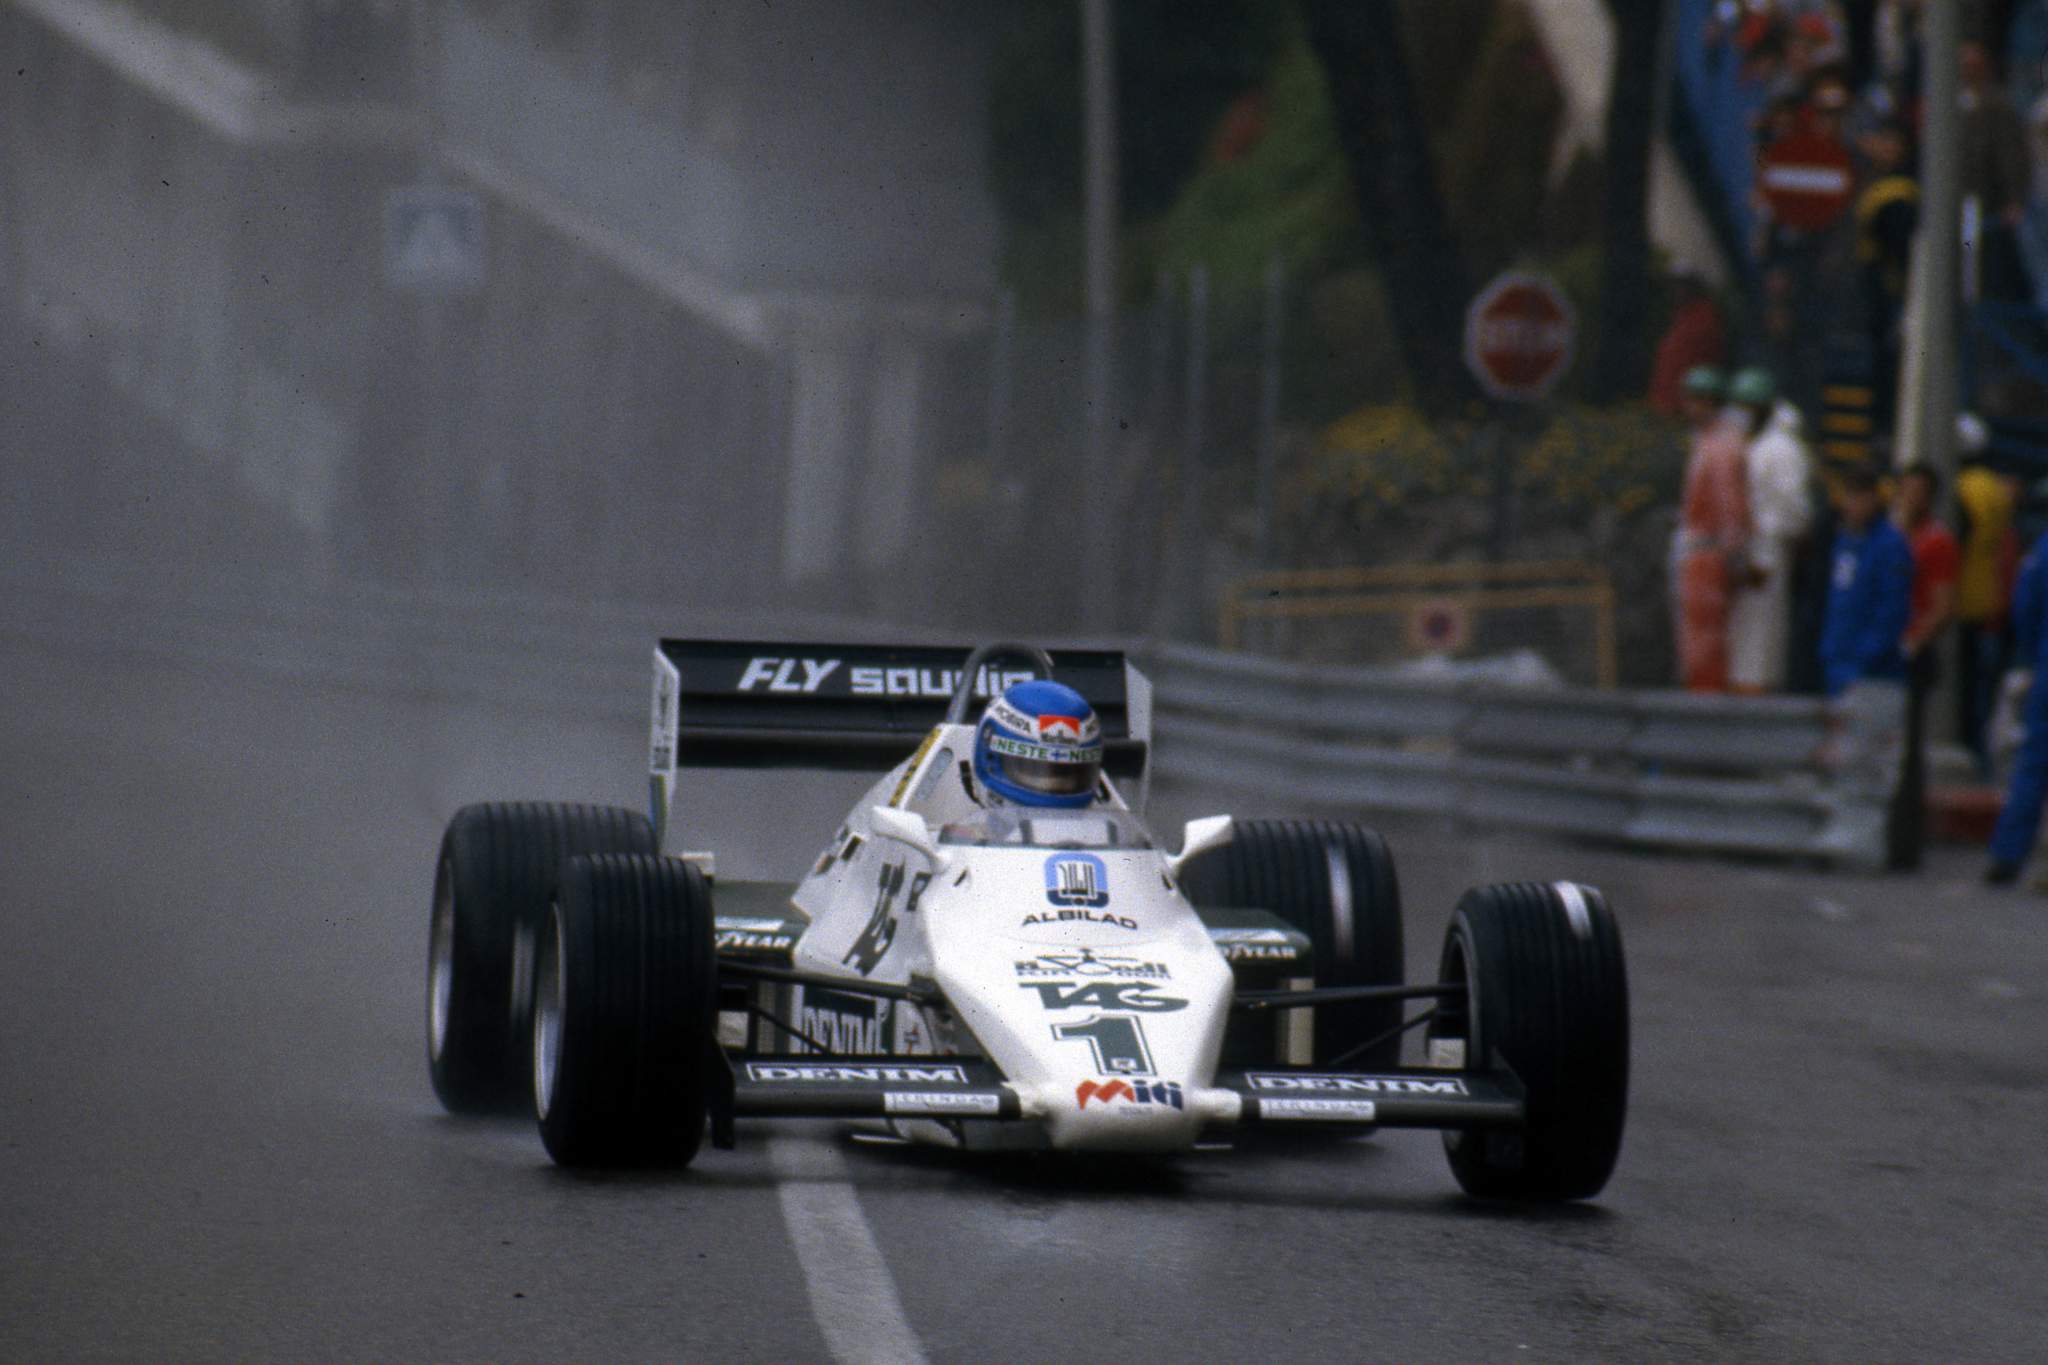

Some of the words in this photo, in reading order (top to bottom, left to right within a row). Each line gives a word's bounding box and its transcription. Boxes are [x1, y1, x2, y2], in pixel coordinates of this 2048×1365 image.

[738, 658, 840, 691] FLY
[996, 739, 1049, 759] NESTE
[1021, 909, 1138, 930] ALBILAD
[715, 931, 792, 948] YEAR
[1019, 981, 1189, 1012] TAG
[1051, 1014, 1158, 1076] 1
[754, 1067, 957, 1083] DENIM
[1254, 1076, 1459, 1094] DENIM
